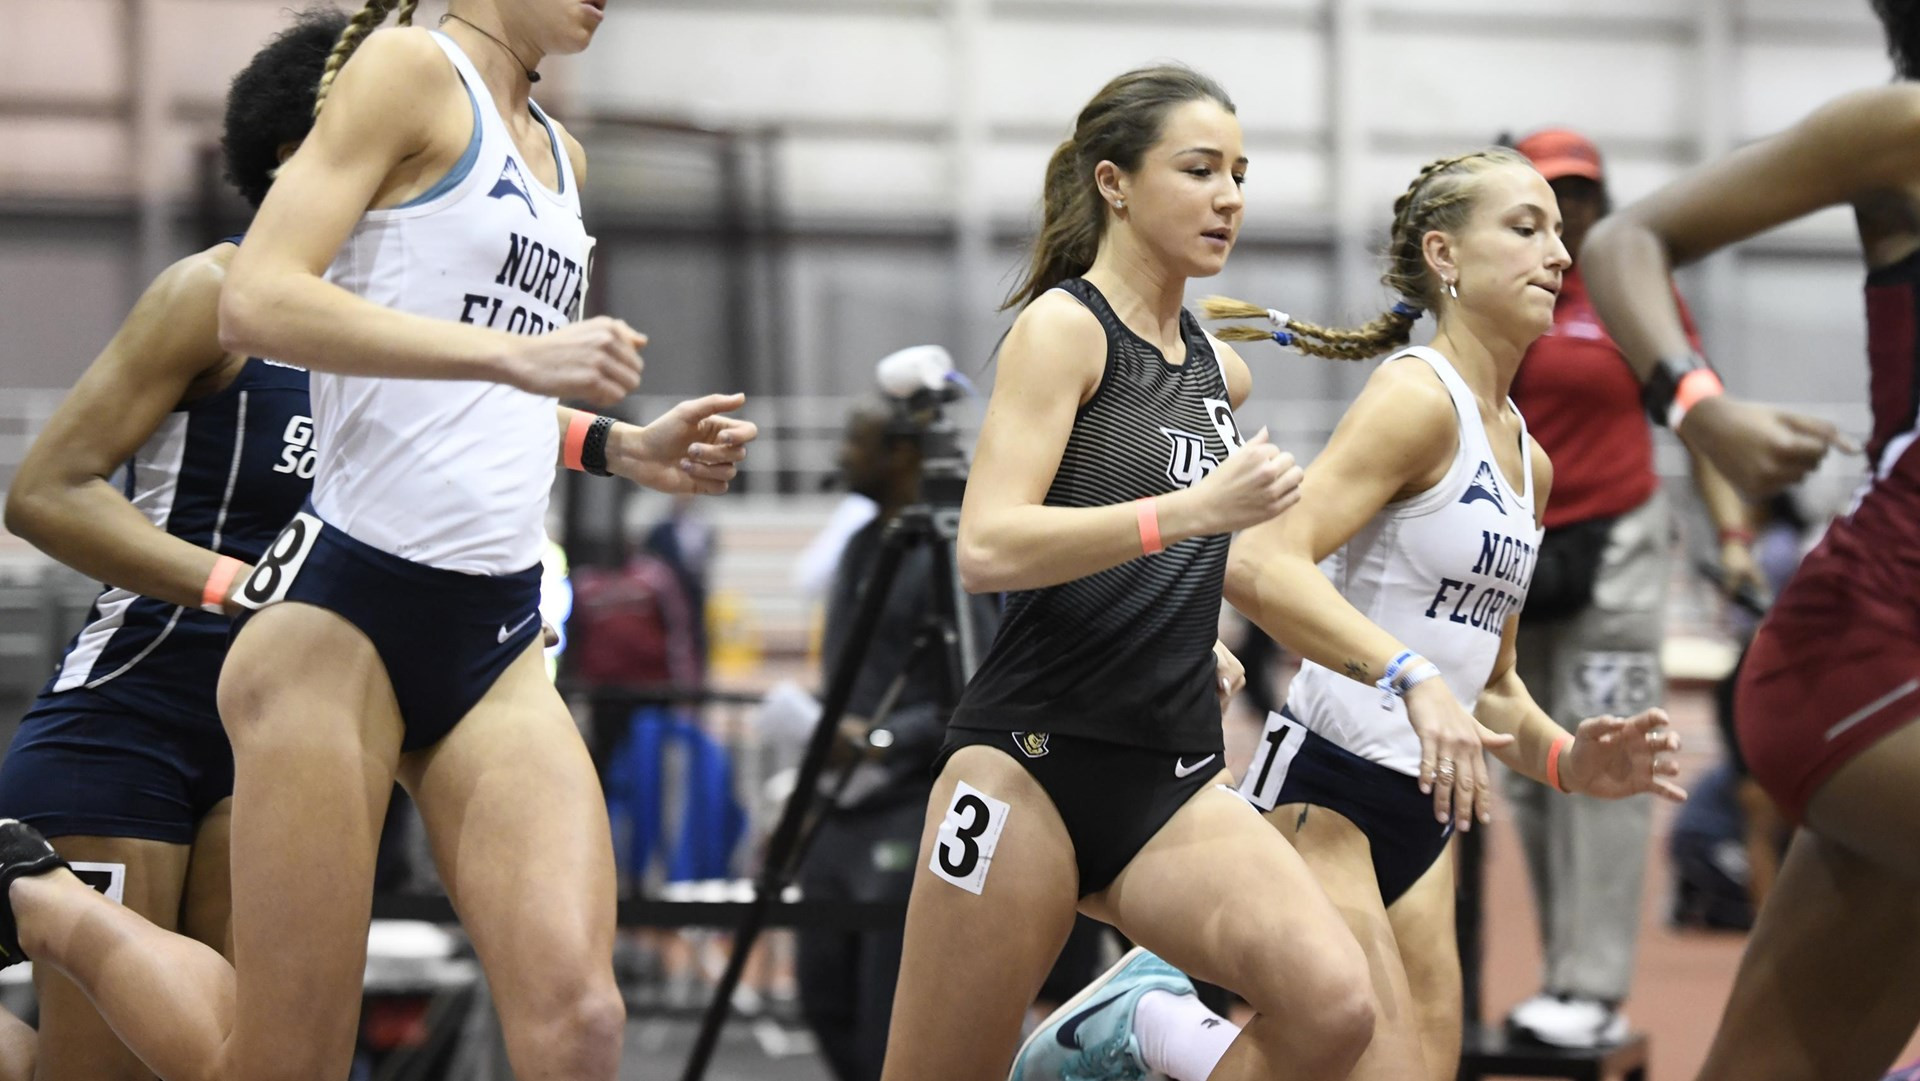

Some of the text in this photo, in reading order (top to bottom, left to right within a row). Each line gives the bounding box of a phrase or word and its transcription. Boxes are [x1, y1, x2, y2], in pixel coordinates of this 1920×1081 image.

[244, 519, 306, 604] 8
[1252, 724, 1291, 798] 1
[938, 794, 990, 878] 3
